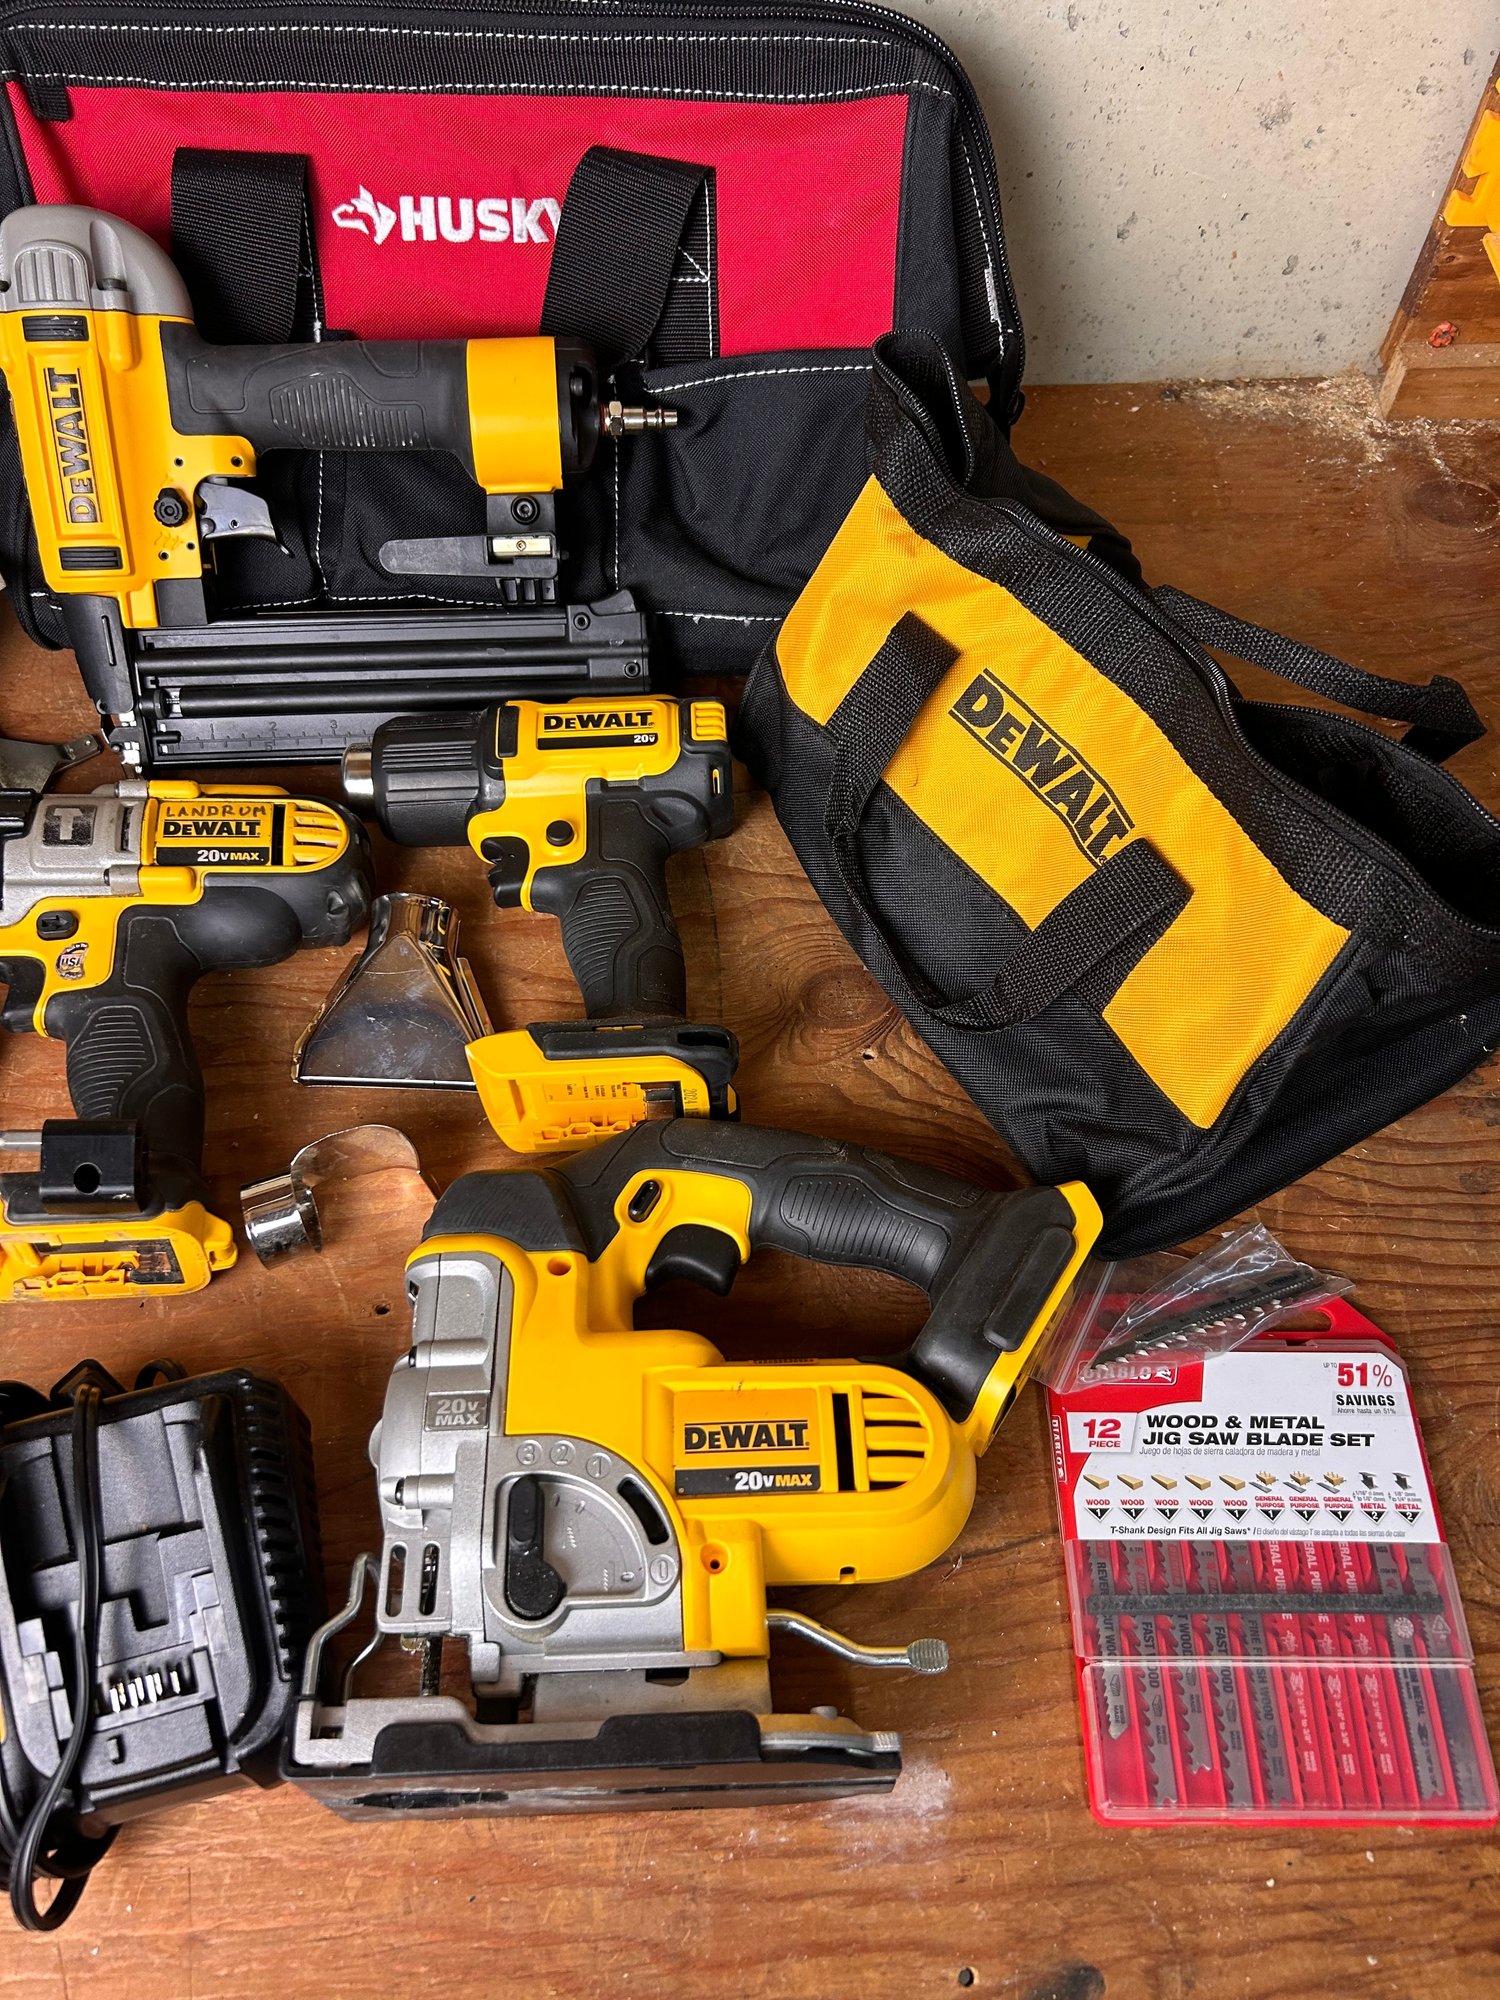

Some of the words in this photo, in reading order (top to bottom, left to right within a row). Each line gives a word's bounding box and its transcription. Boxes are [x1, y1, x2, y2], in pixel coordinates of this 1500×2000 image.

[543, 712, 653, 731] DEWALT
[952, 673, 1130, 859] DEWALT
[166, 805, 267, 817] LANDRUM
[163, 821, 261, 836] DEWALT
[1336, 1394, 1396, 1407] SAVINGS
[435, 1412, 479, 1426] MAX
[1146, 1415, 1218, 1428] WOOD
[1225, 1415, 1242, 1429] &
[1250, 1416, 1325, 1429] METAL
[1083, 1418, 1122, 1438] 12
[685, 1423, 808, 1450] DEWALT
[1142, 1431, 1181, 1445] JIG
[1188, 1432, 1239, 1445] SAW
[1246, 1432, 1324, 1446] BLADE
[1330, 1433, 1375, 1447] SET
[1089, 1440, 1121, 1448] PIECE
[1139, 1447, 1161, 1457] Juego
[1162, 1447, 1171, 1455] de
[1173, 1447, 1192, 1457] hojas
[1194, 1447, 1202, 1455] de
[1204, 1447, 1223, 1455] sierra
[1256, 1447, 1265, 1456] de
[1267, 1448, 1293, 1456] madera
[1301, 1448, 1321, 1456] metal
[775, 1473, 813, 1487] MAX
[1095, 1509, 1101, 1517] 1
[1130, 1509, 1136, 1517] 1
[1165, 1509, 1170, 1517] 1
[1200, 1509, 1205, 1517] 1
[1234, 1510, 1239, 1518] 1
[1268, 1510, 1273, 1518] 1
[1303, 1510, 1308, 1518] 1
[1338, 1511, 1343, 1519] 1
[1371, 1511, 1378, 1520] 2
[1406, 1512, 1413, 1520] 2
[1111, 1526, 1145, 1534] T-Shank
[1147, 1526, 1176, 1536] Design
[1179, 1526, 1194, 1534] Fits
[1209, 1527, 1222, 1536] Jig
[1142, 1622, 1155, 1649] FAST
[1214, 1626, 1228, 1656] FAST
